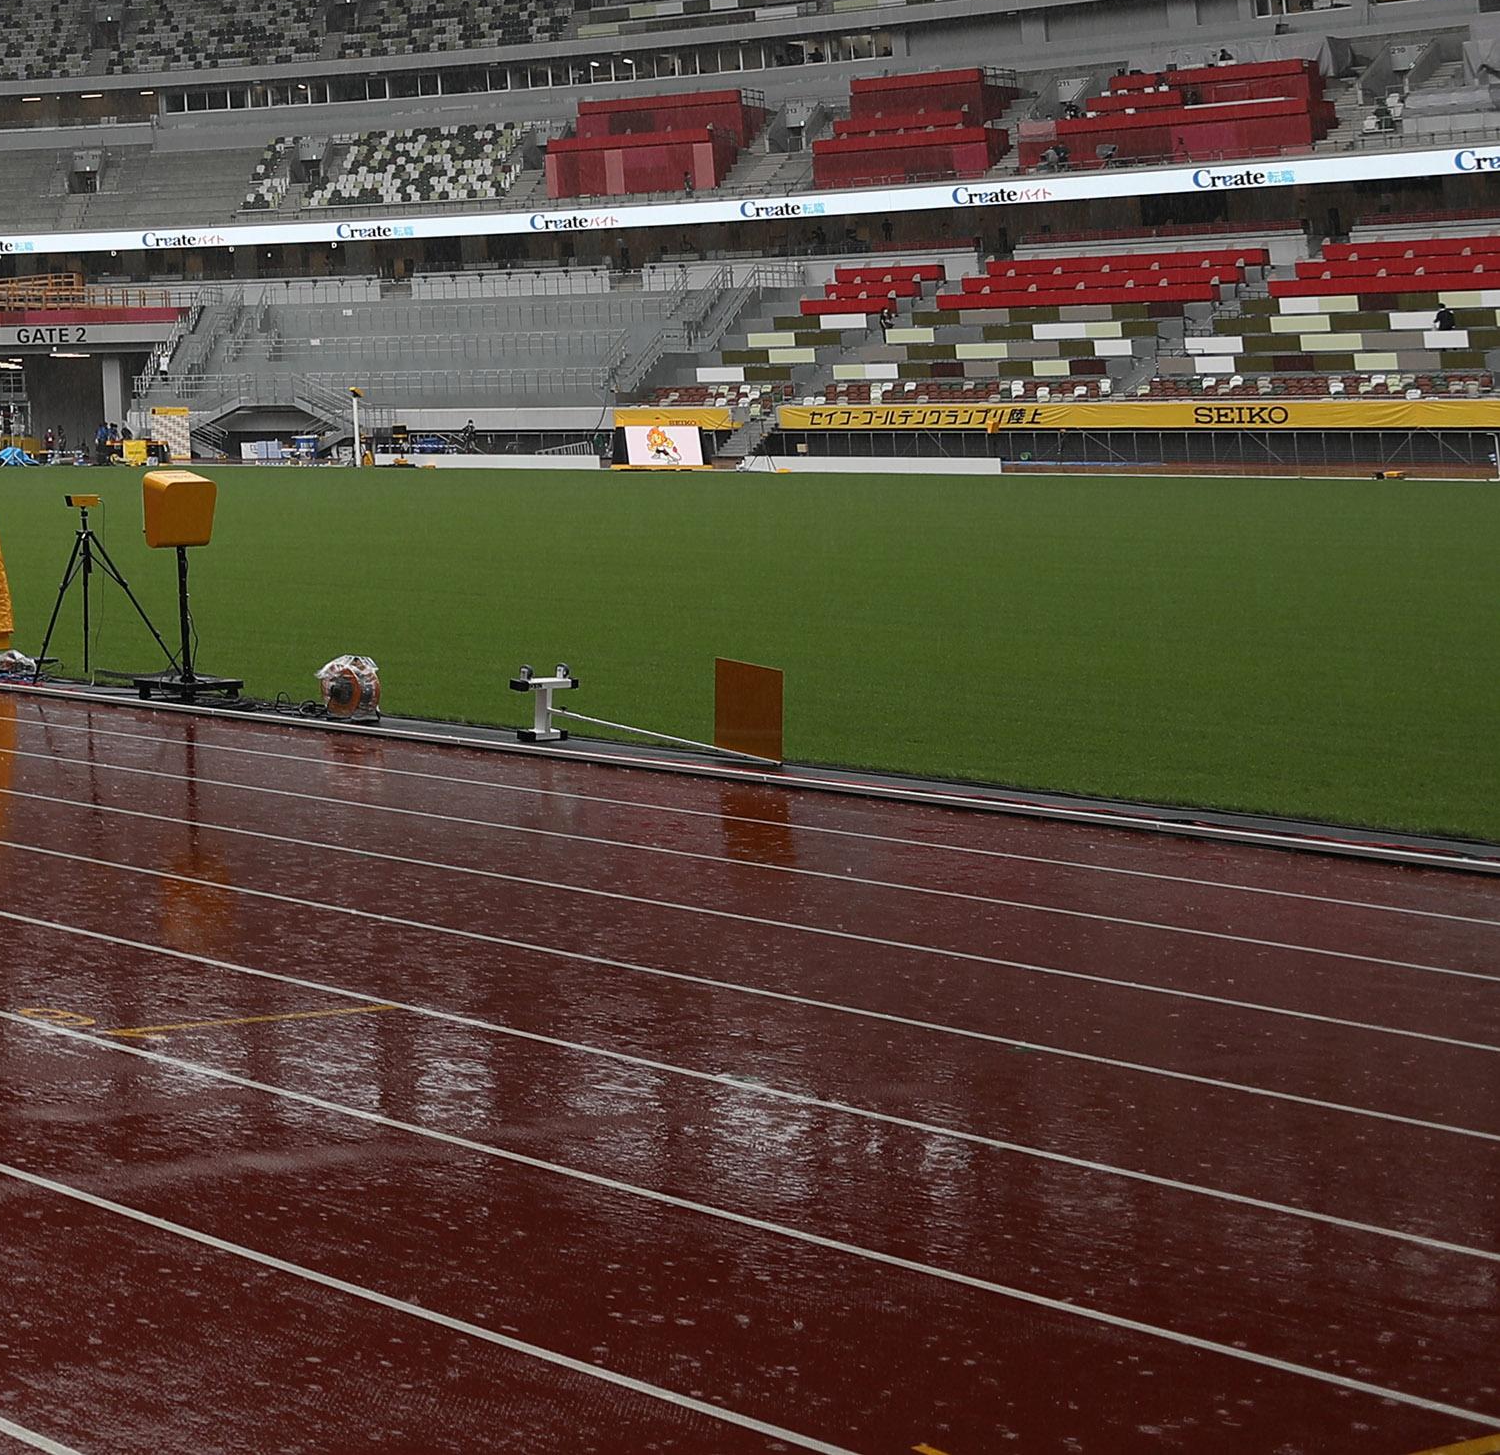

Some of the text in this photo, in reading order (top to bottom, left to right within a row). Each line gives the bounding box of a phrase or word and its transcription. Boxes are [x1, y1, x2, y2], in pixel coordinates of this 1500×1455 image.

[17, 327, 87, 344] GATE 2
[1194, 405, 1289, 425] SEIKO
